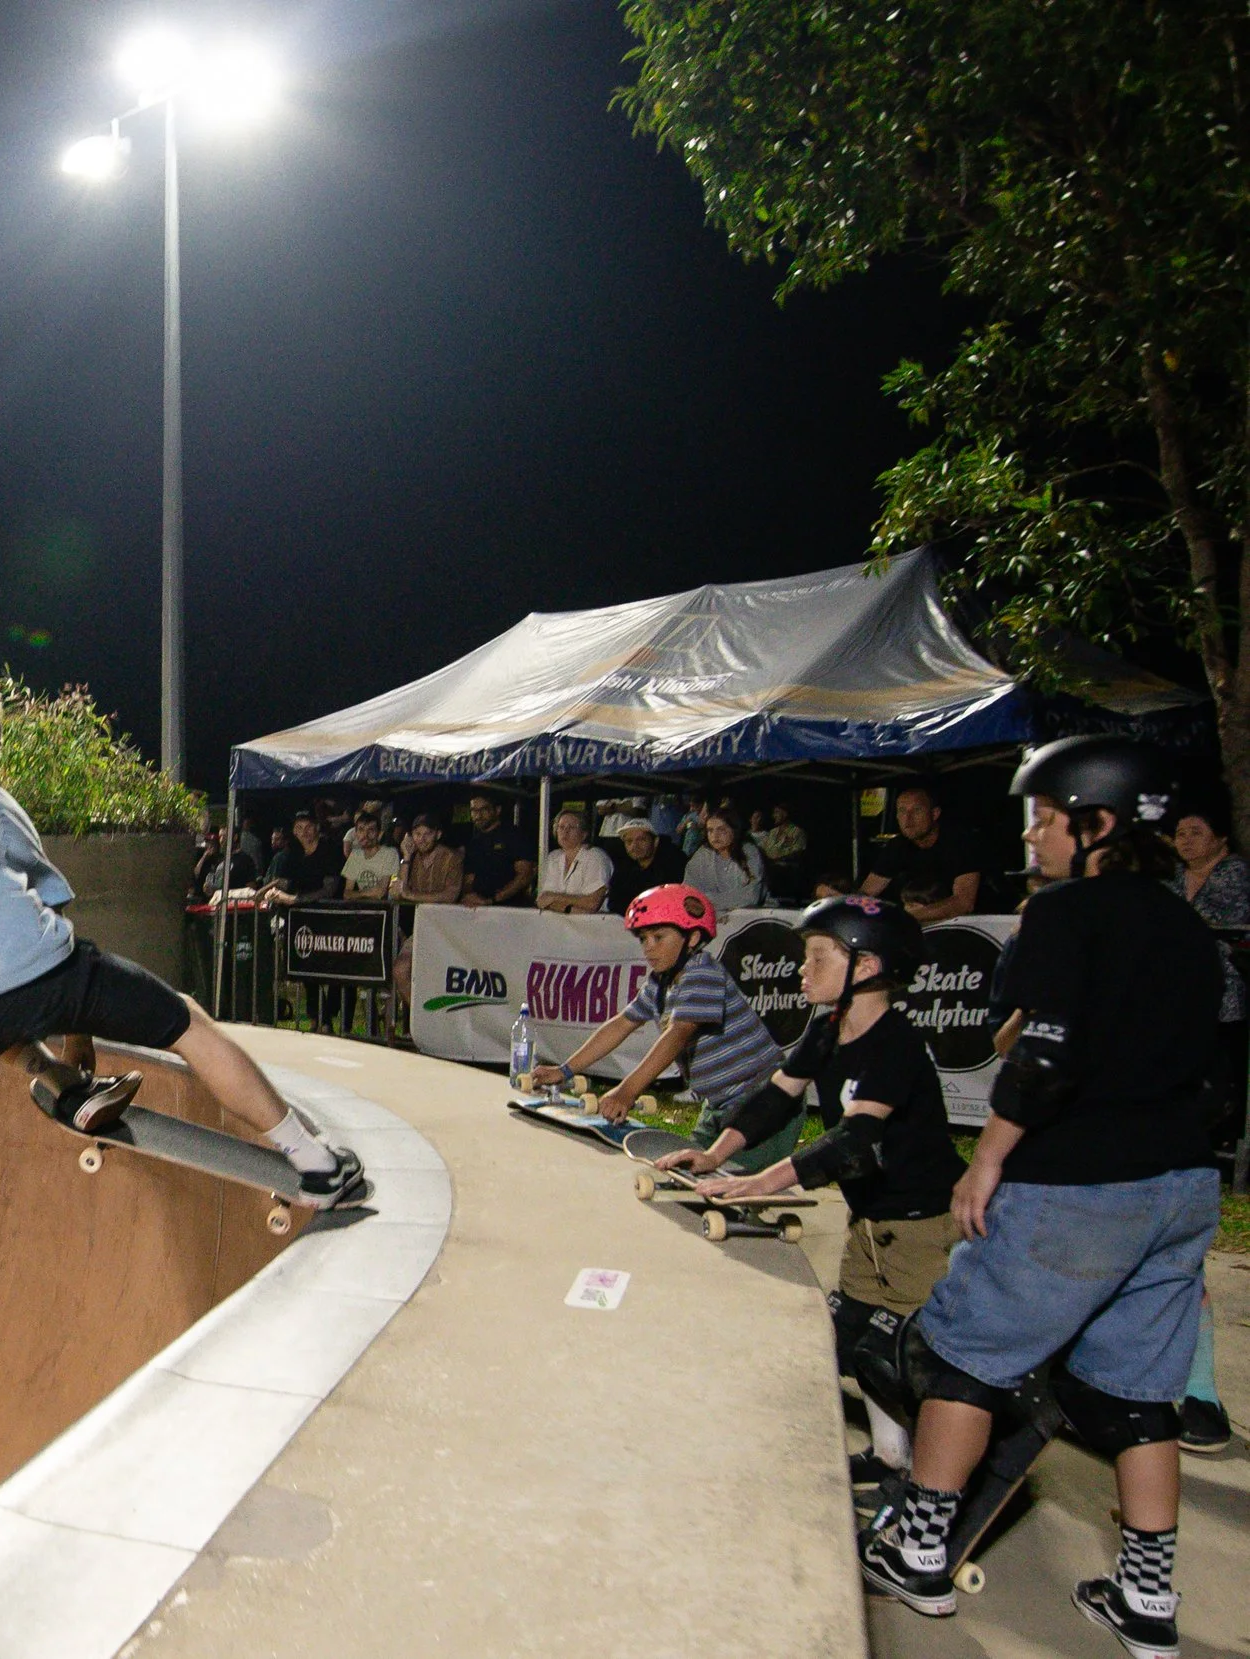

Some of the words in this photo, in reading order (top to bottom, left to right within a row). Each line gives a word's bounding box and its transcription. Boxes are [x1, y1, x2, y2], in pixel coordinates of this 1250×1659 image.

[314, 935, 345, 952] KILLER
[347, 936, 375, 954] PADS
[445, 965, 508, 999] BMD
[740, 953, 796, 981] Skate
[907, 962, 983, 994] Skate
[526, 961, 647, 1023] RUMBLE
[744, 985, 807, 1017] ulpture
[892, 998, 990, 1034] ulptur
